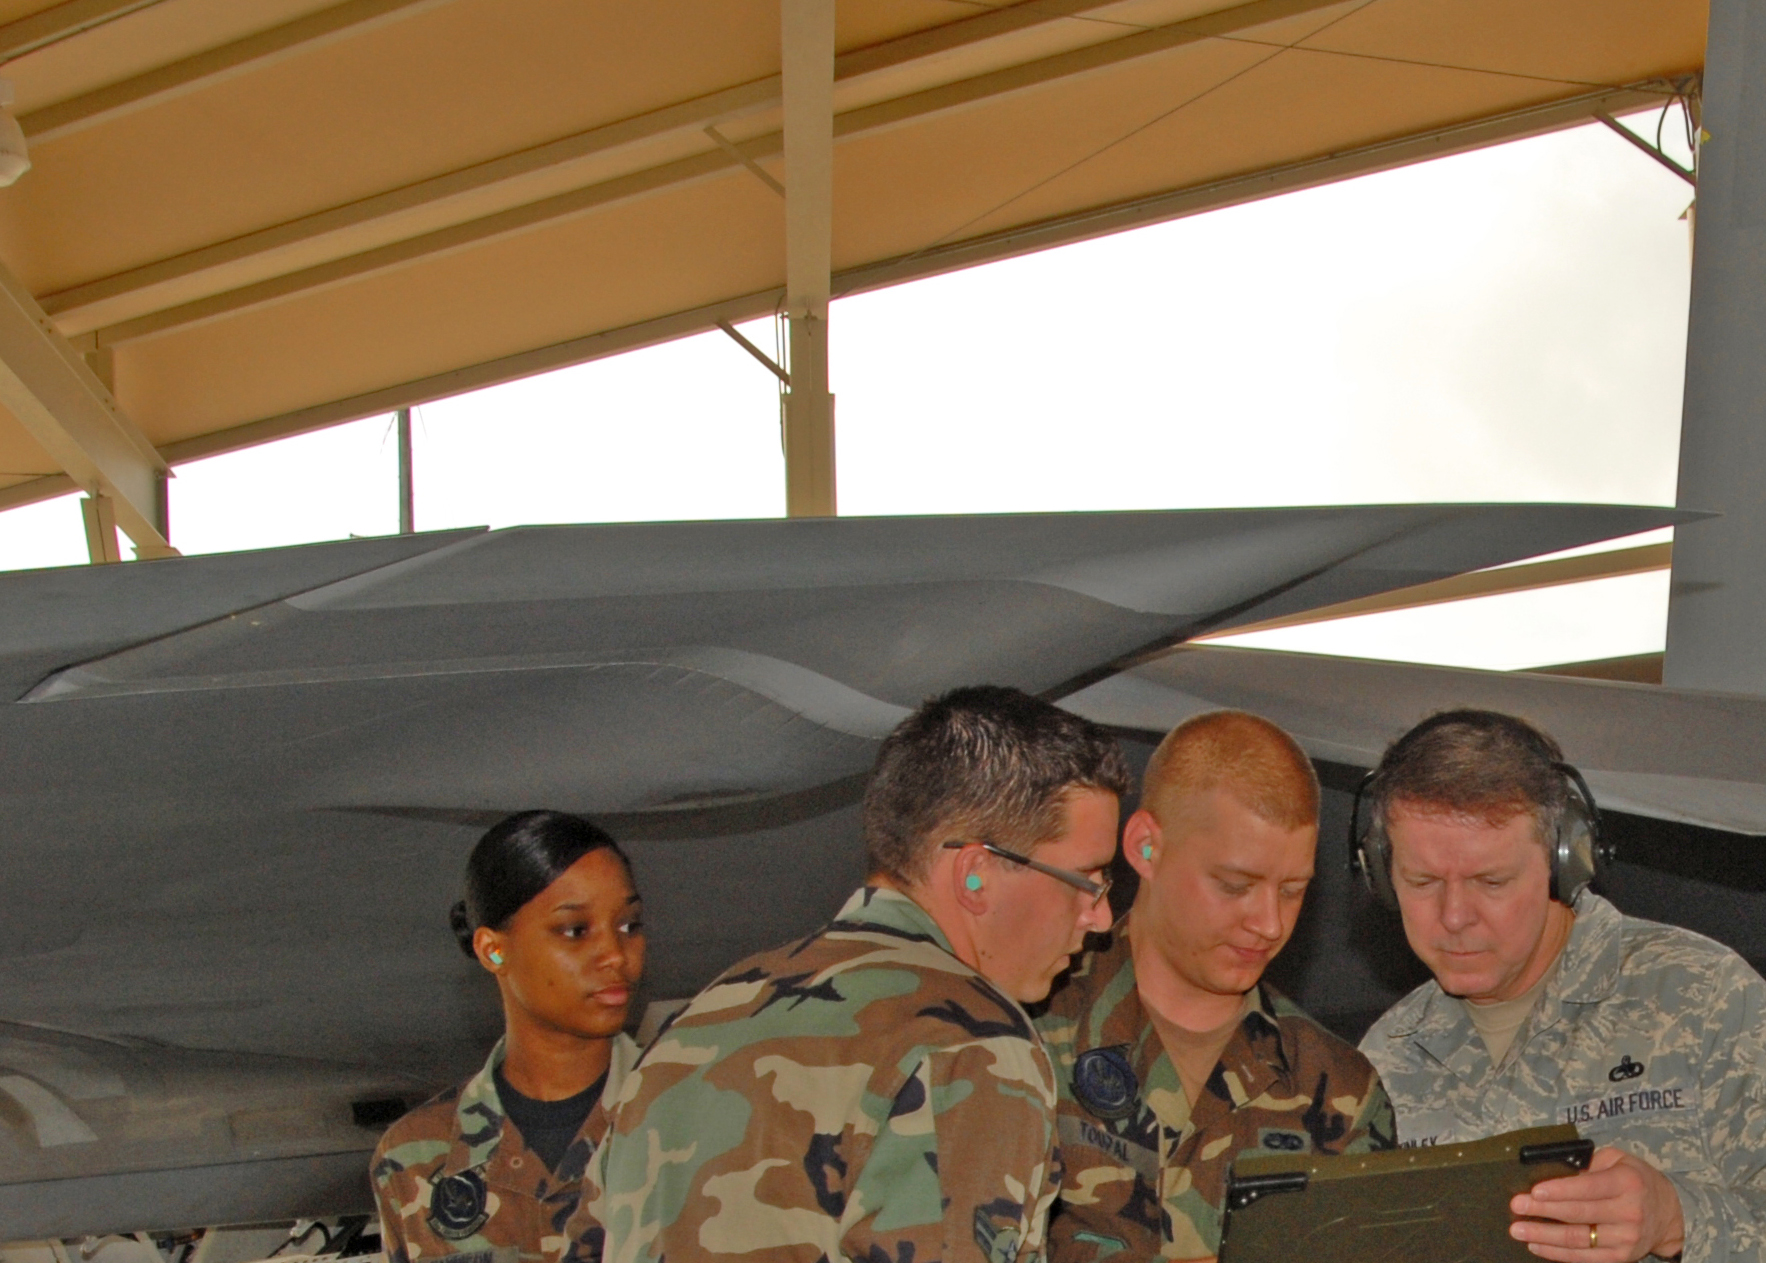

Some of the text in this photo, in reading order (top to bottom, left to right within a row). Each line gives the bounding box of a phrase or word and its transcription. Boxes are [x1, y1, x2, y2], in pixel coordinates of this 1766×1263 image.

[1566, 1088, 1685, 1125] U.S. AIR FORCE
